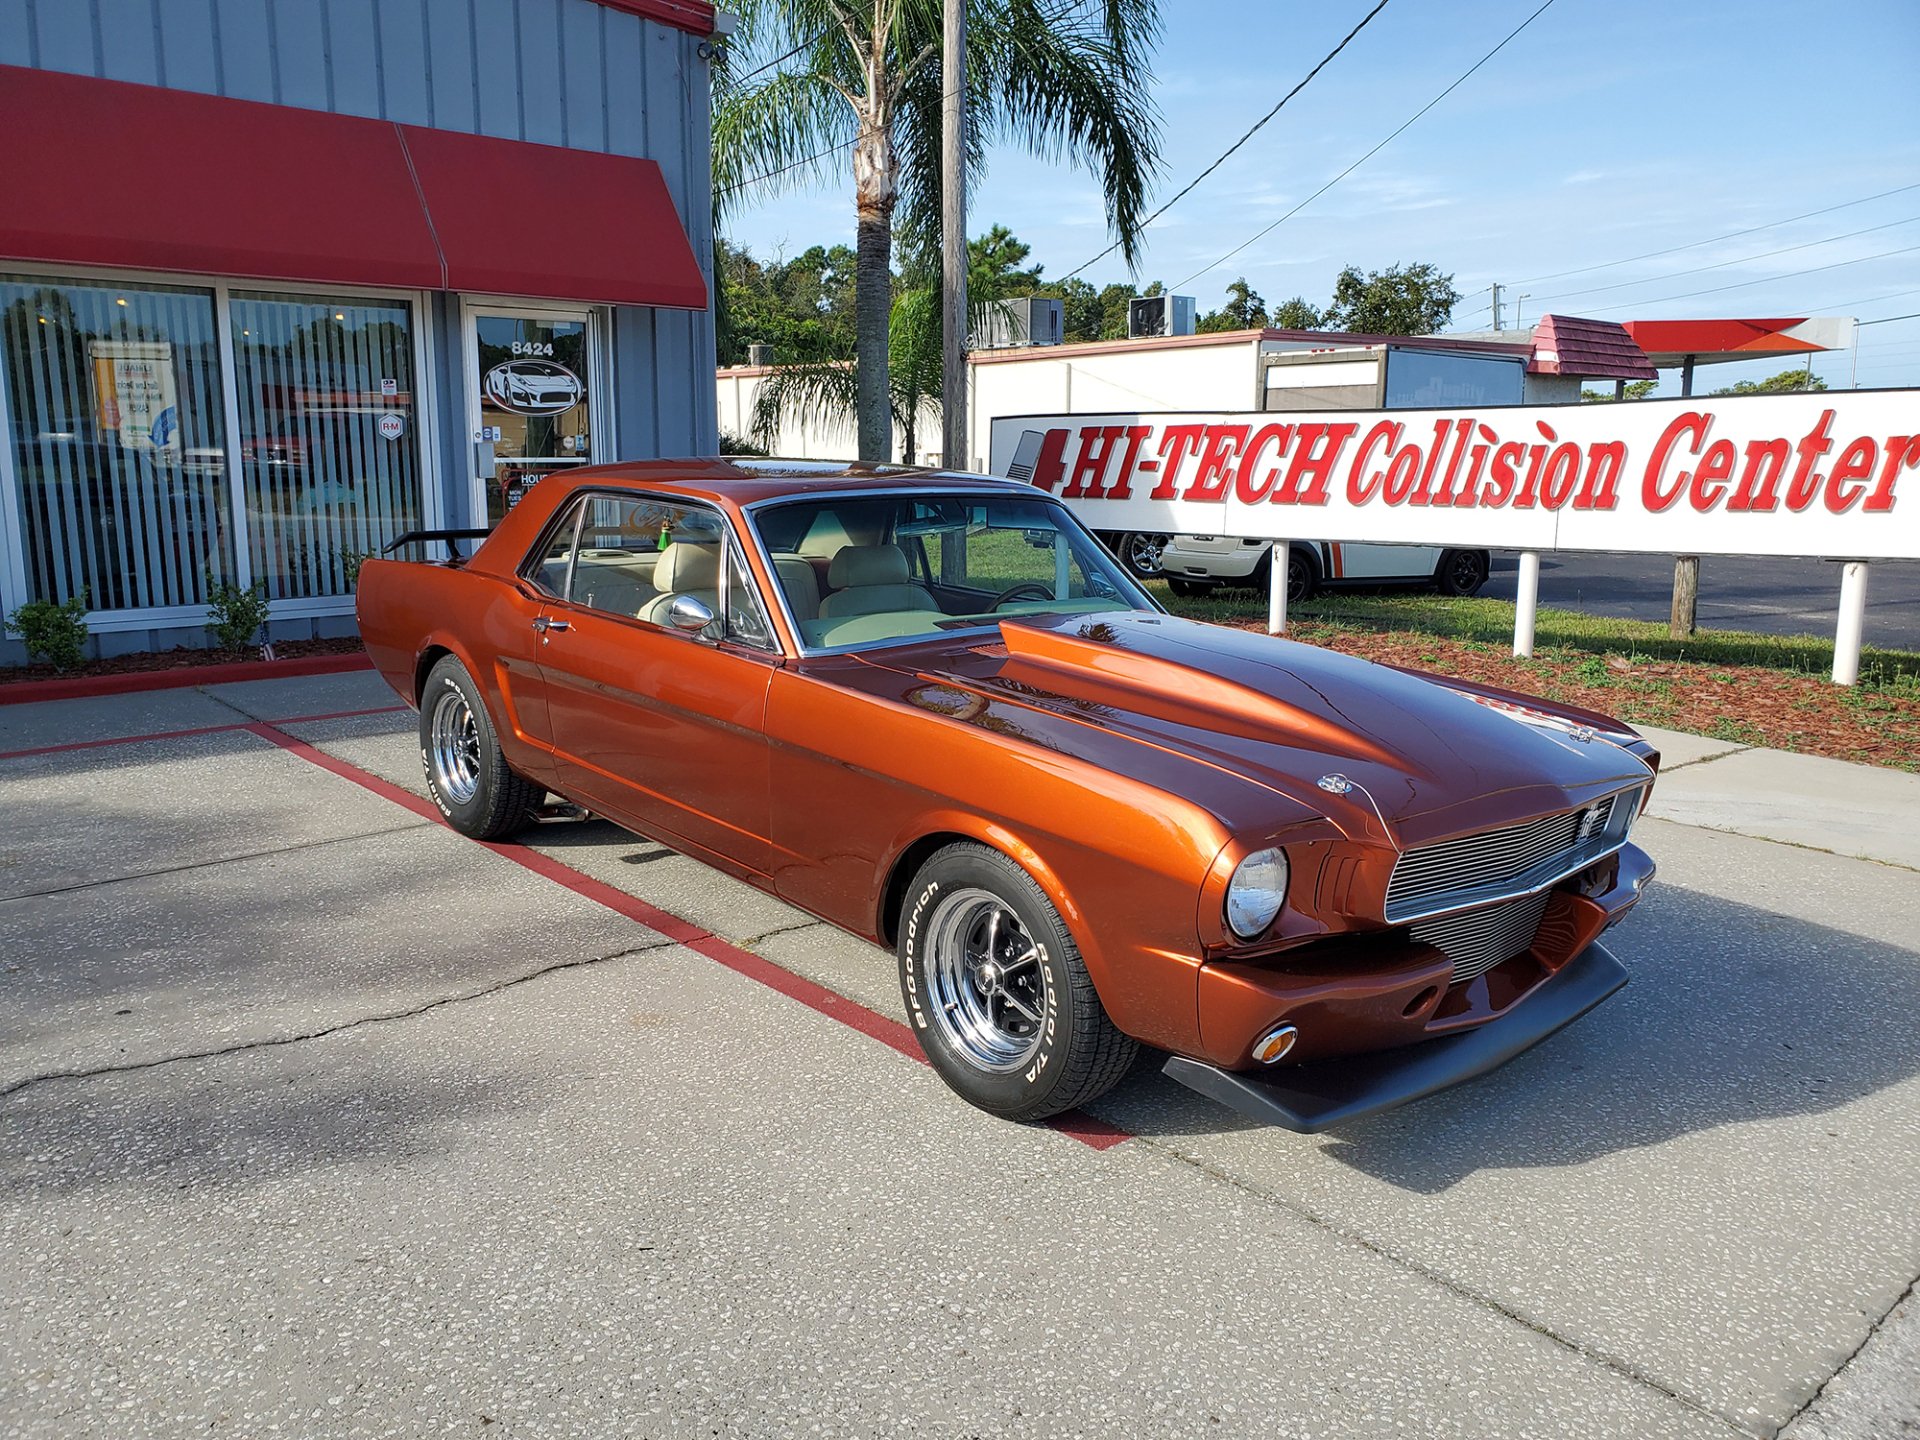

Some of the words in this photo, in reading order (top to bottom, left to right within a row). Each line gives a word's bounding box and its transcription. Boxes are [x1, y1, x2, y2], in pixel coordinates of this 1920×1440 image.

[511, 341, 554, 356] 8424
[1061, 422, 1359, 506] HI-TECH
[1345, 418, 1628, 512] Collision
[1641, 408, 1920, 514] Center
[906, 881, 939, 1029] BFGoodrich
[1036, 943, 1058, 1046] Radial
[1025, 1052, 1048, 1083] T/A
